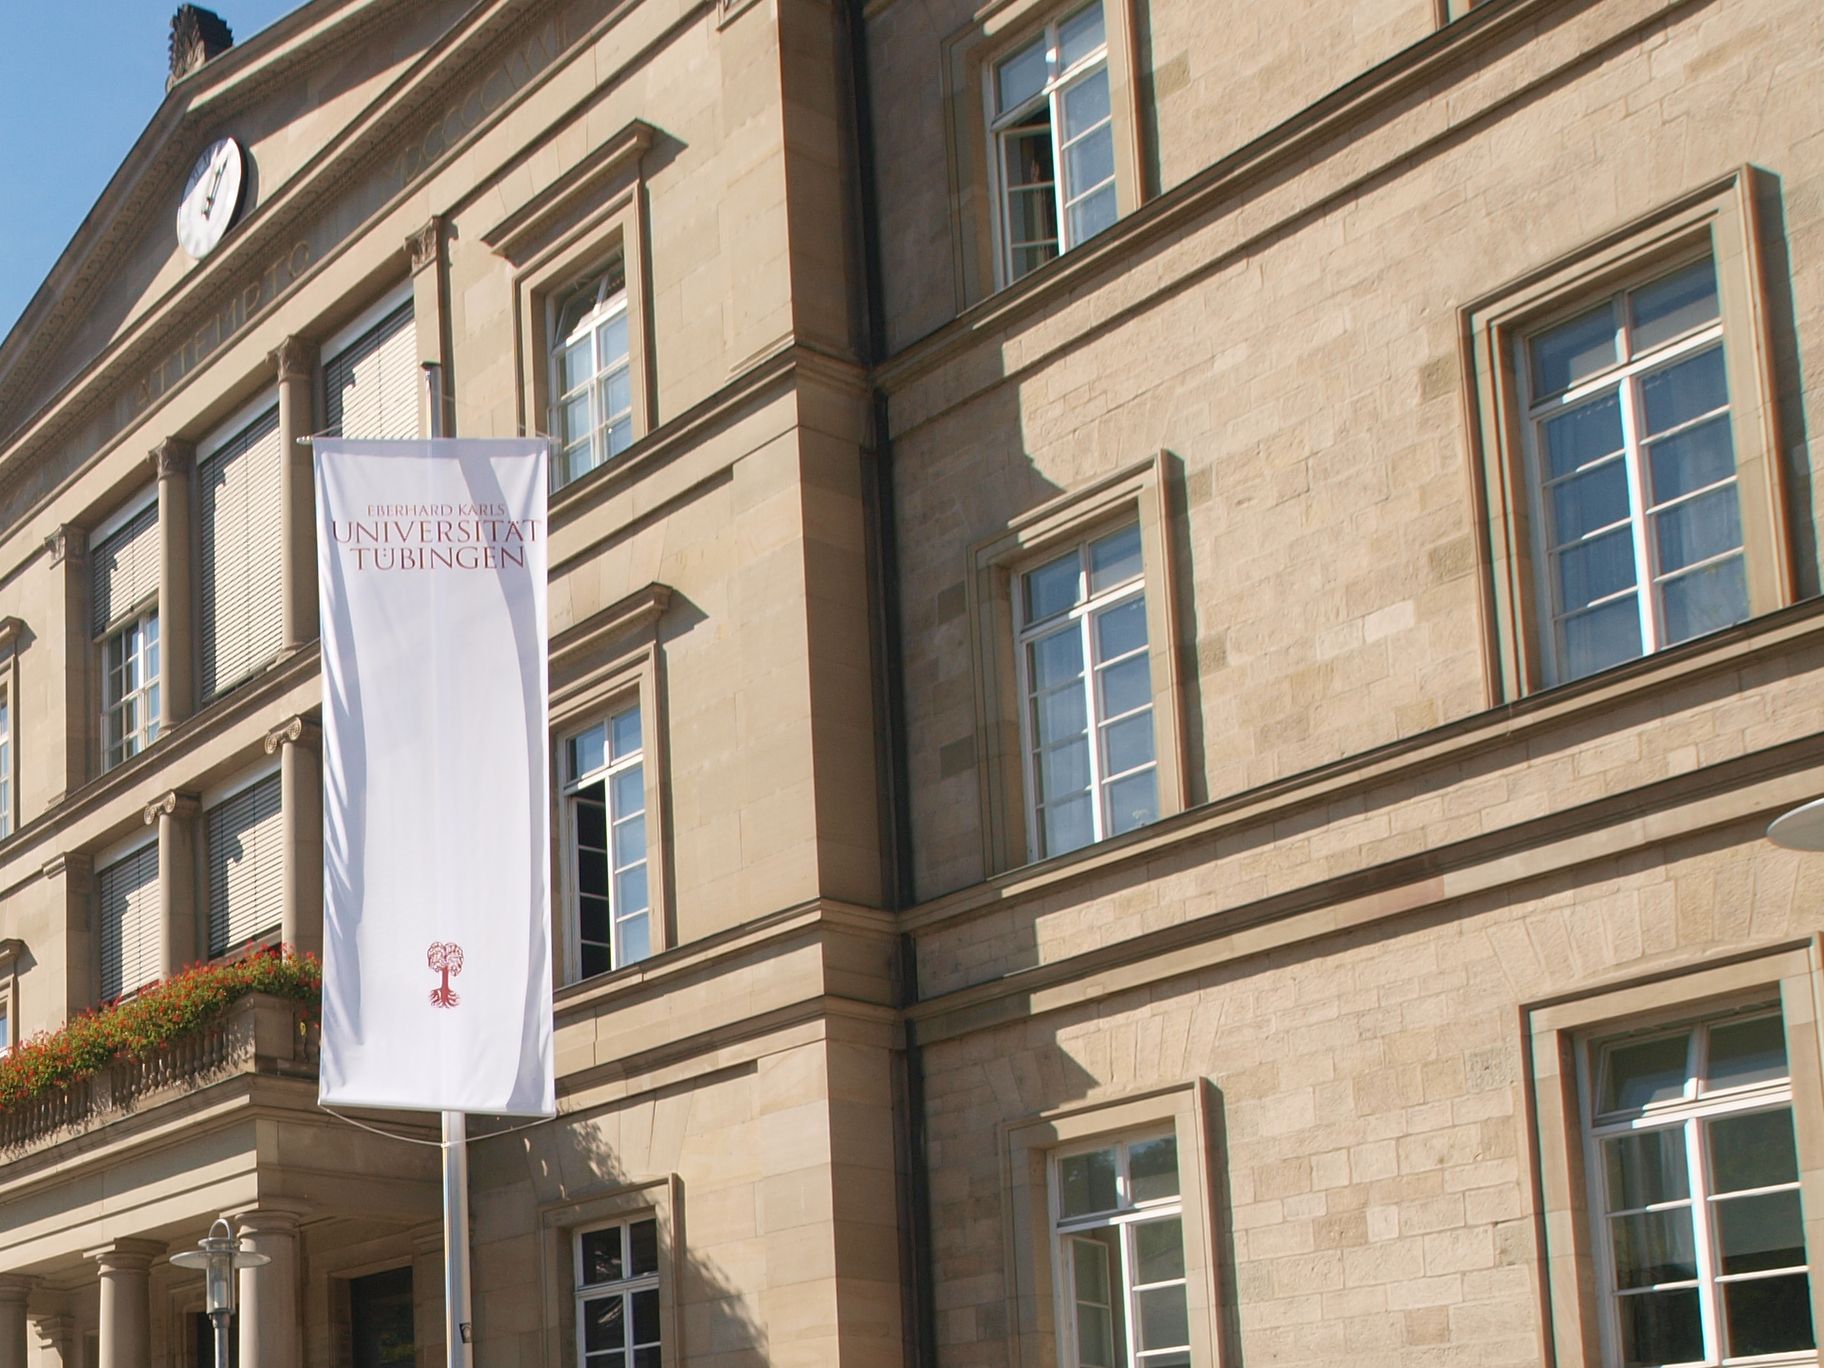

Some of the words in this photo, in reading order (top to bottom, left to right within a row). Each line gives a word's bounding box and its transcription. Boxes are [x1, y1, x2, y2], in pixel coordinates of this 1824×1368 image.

[138, 240, 309, 404] ATTEMPTO
[367, 504, 453, 517] EBERHARD
[458, 503, 506, 517] KARLS
[331, 519, 542, 544] UNIVERSITÄT
[349, 545, 525, 571] TÜBINGEN
